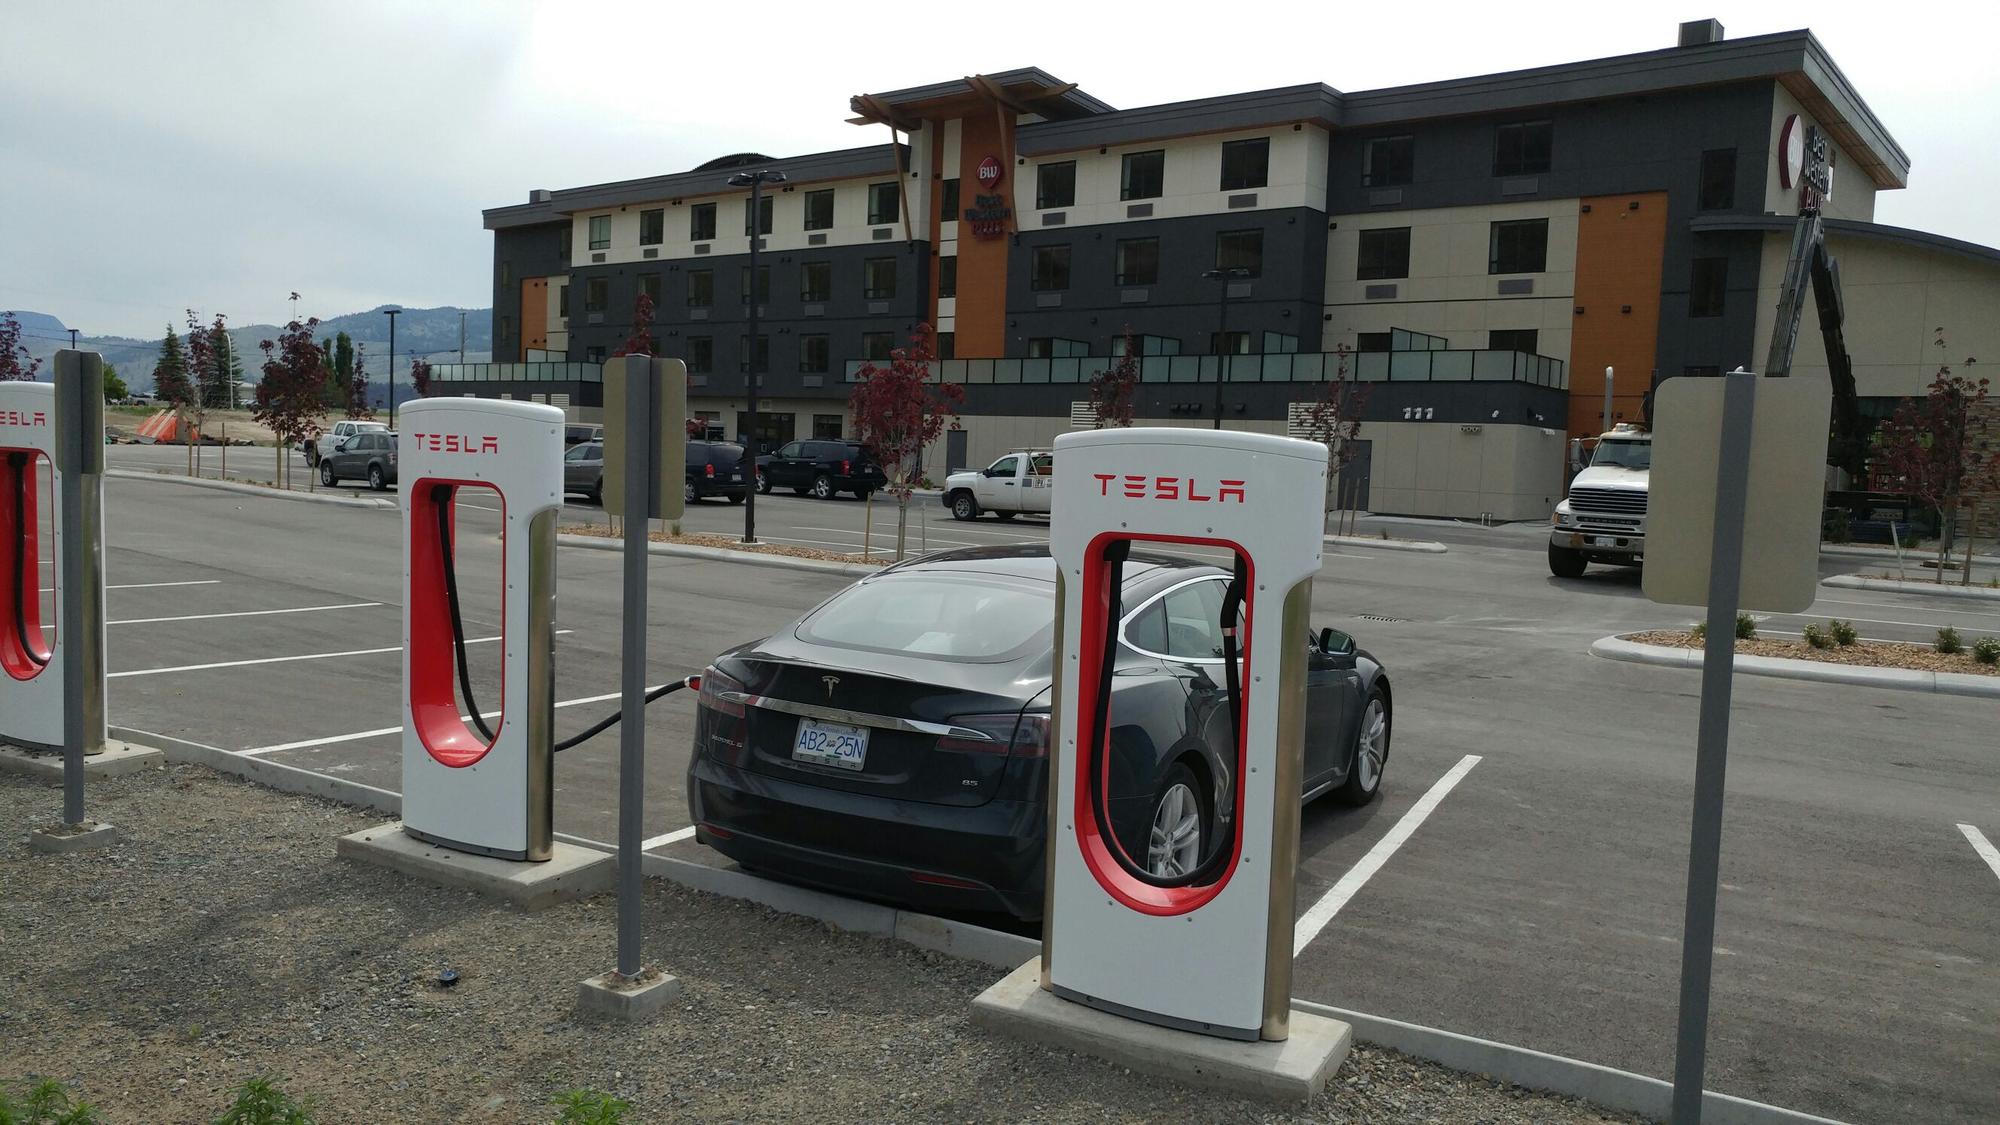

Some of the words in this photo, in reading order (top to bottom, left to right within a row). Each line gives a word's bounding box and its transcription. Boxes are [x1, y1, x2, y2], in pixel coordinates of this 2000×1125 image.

[980, 166, 998, 179] BW
[0, 411, 46, 426] ESLA
[414, 433, 498, 454] TESLA
[1093, 474, 1246, 503] TESLA
[798, 729, 827, 752] AB2
[834, 735, 865, 759] 25N
[962, 779, 979, 787] 85
